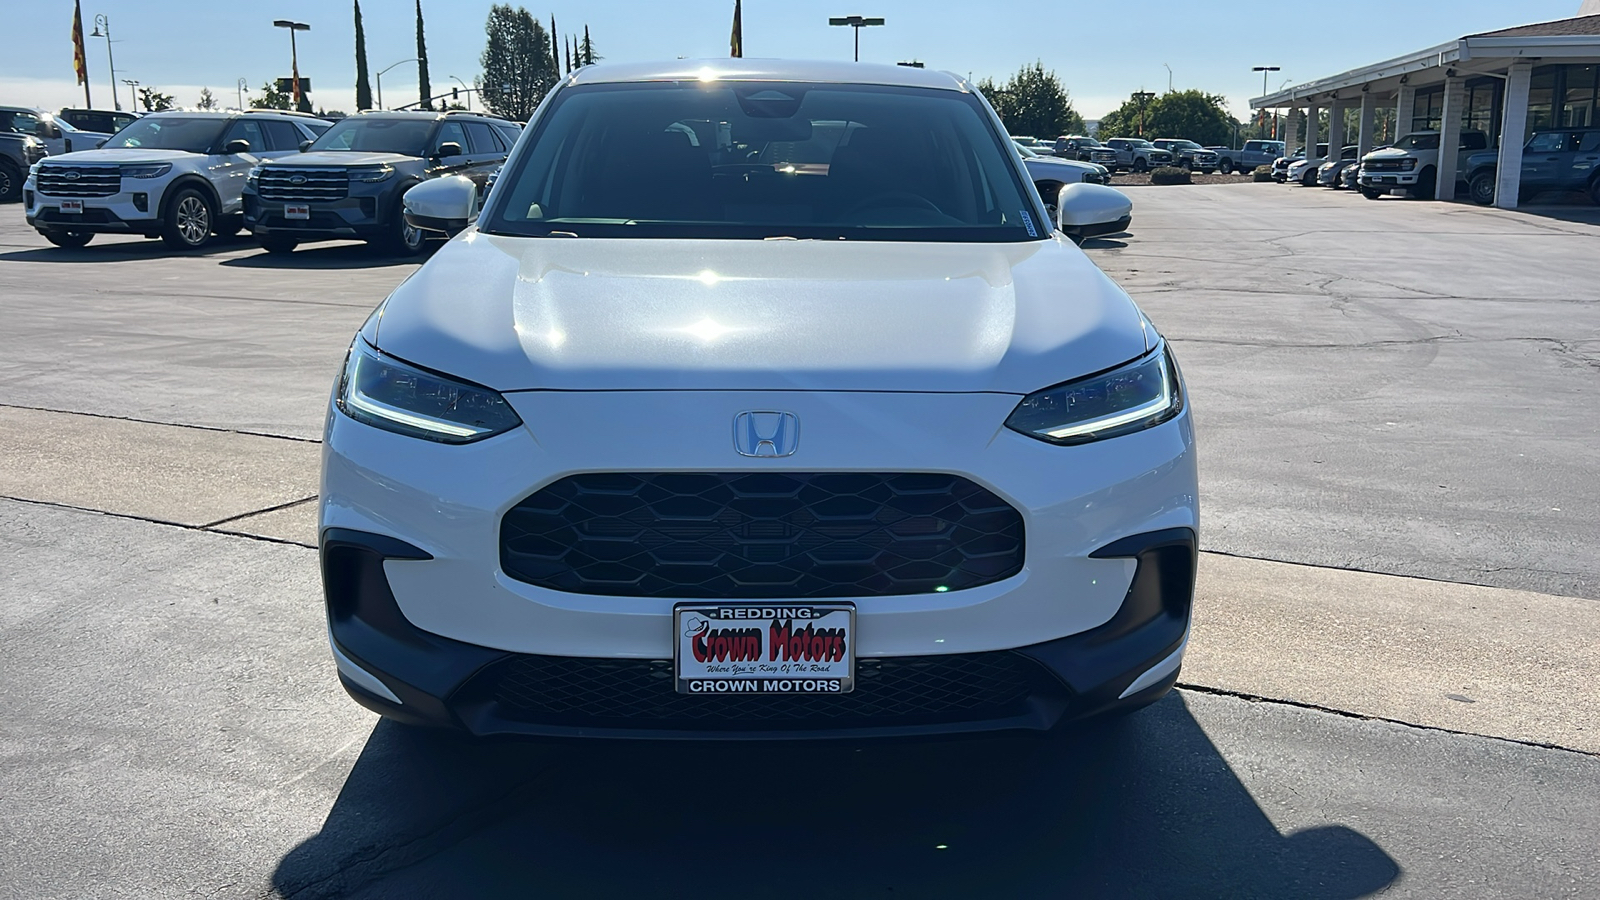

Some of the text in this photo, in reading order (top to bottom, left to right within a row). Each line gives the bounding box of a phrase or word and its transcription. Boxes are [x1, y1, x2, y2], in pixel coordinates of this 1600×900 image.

[720, 608, 811, 619] REDDING
[691, 619, 846, 663] Crown Motors
[706, 663, 831, 676] Where You're King Of The Road
[689, 680, 840, 692] CROWN MOTORS
